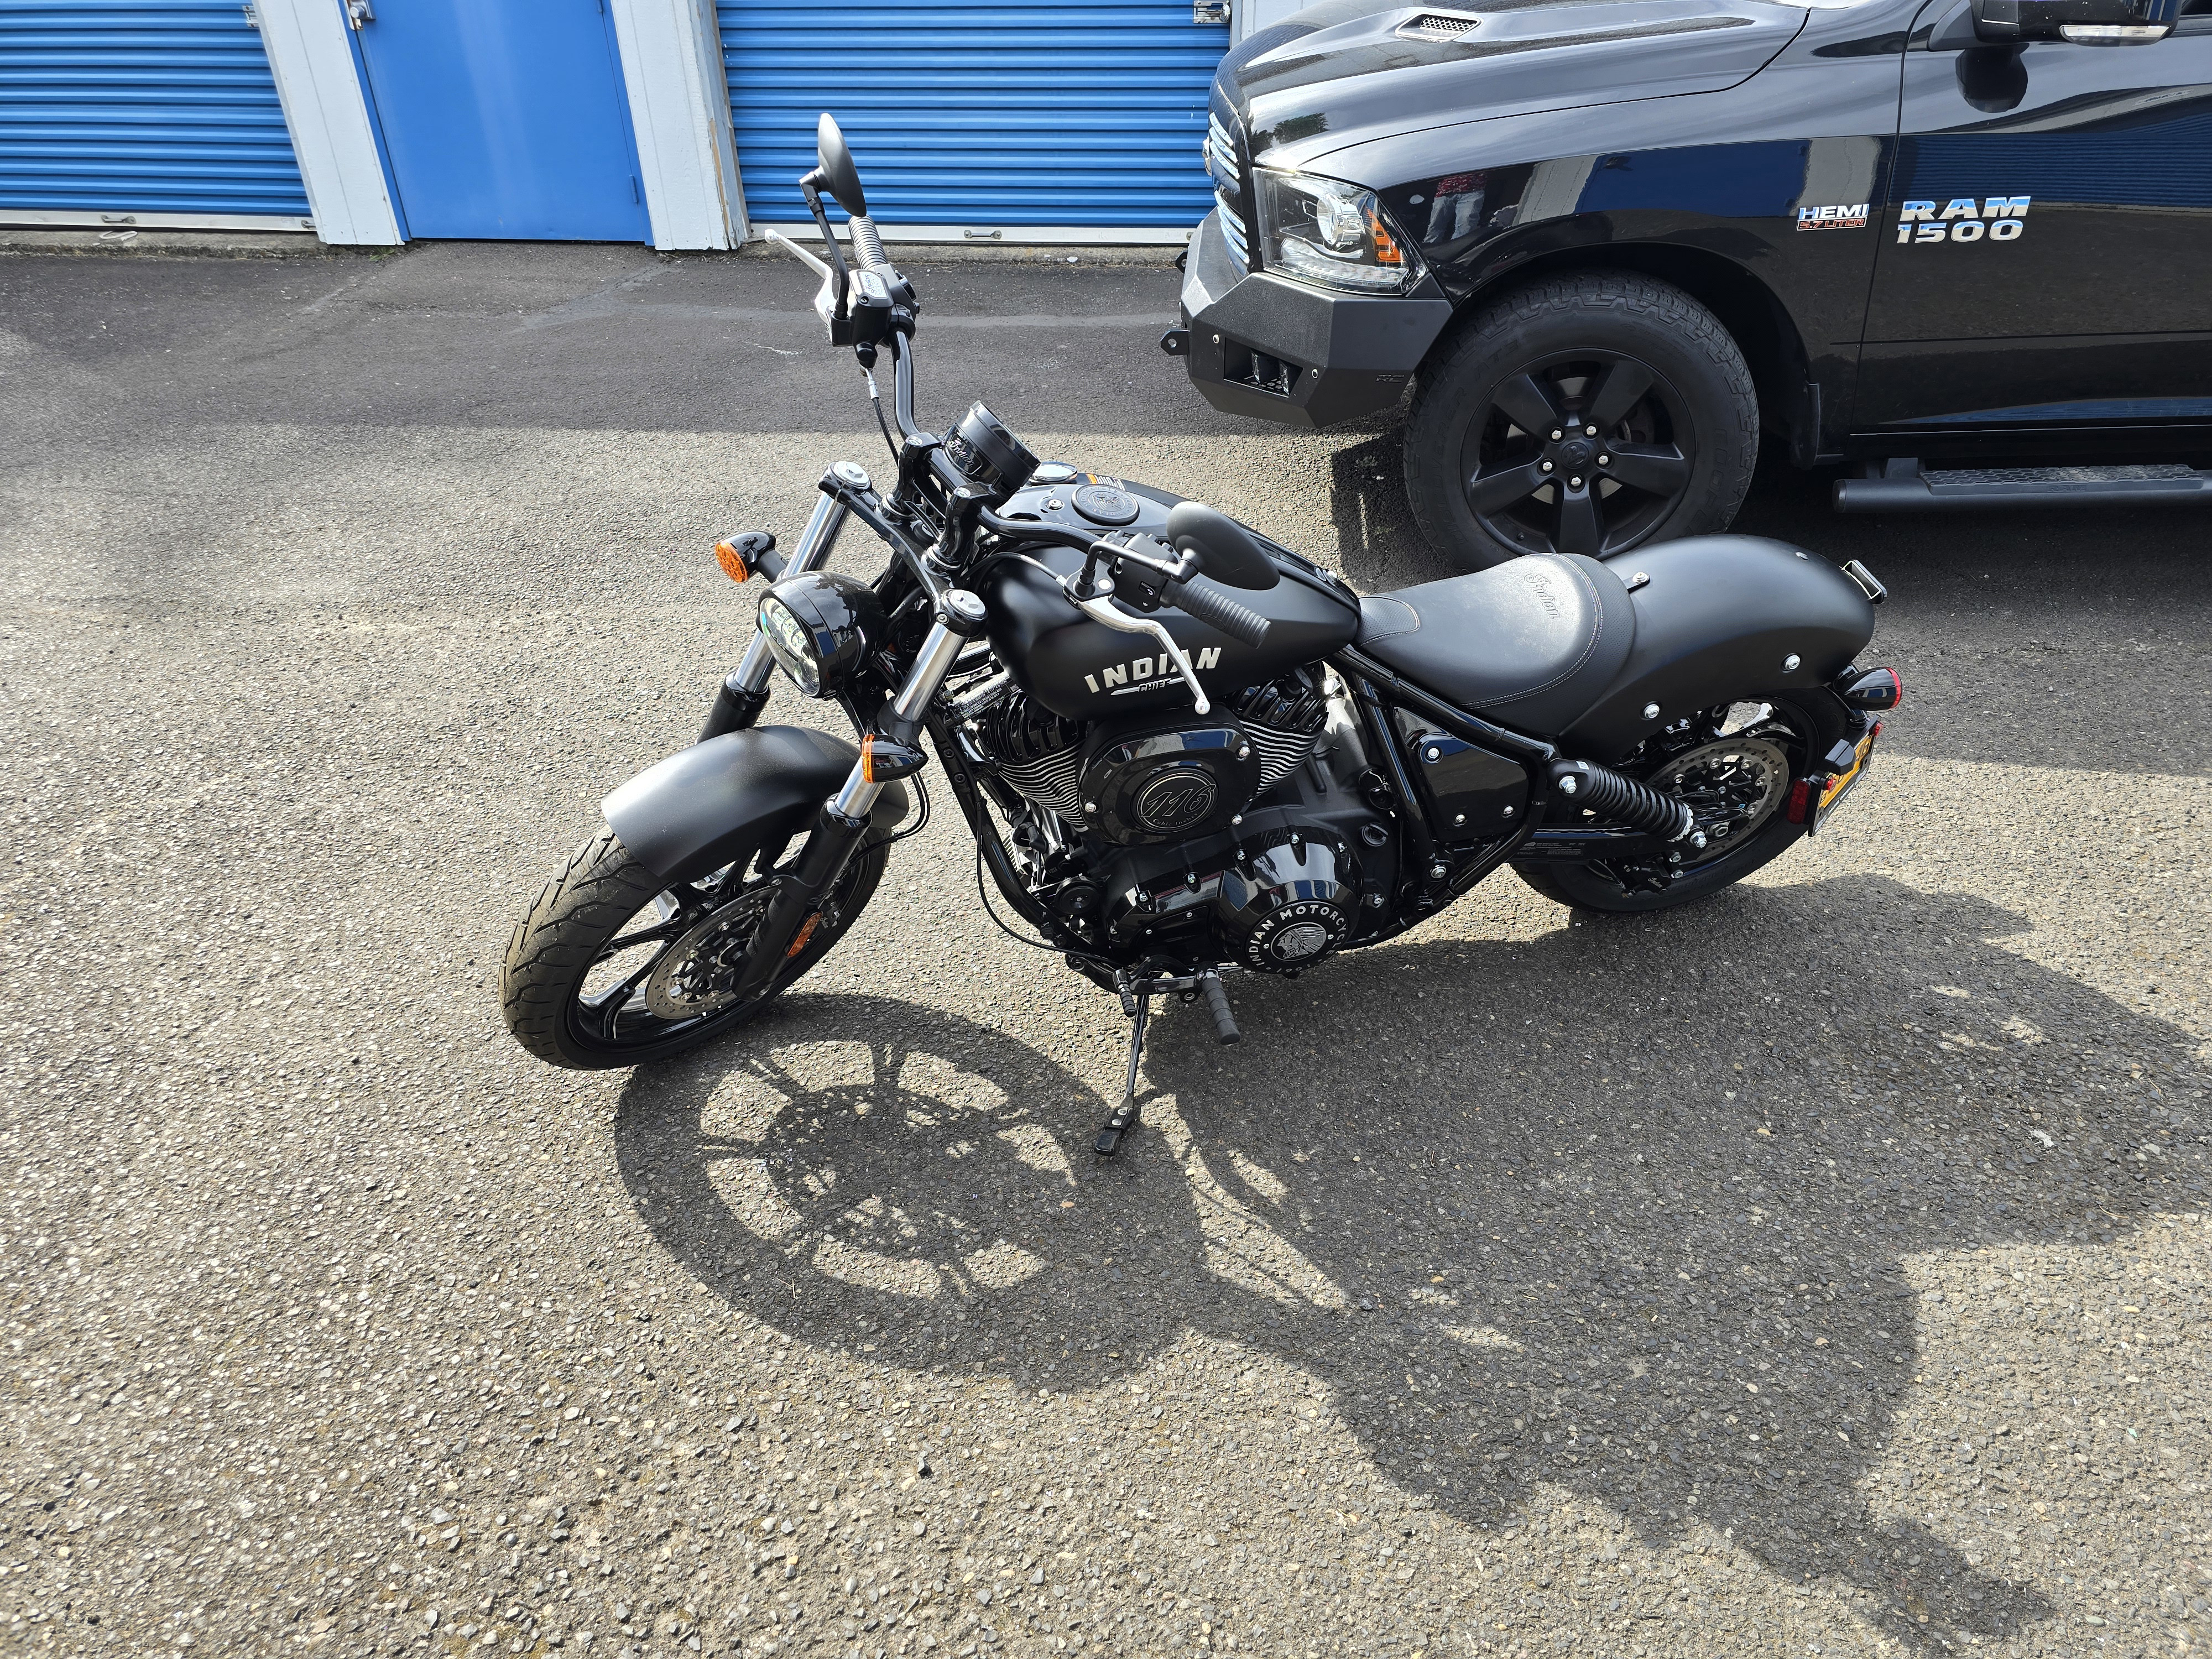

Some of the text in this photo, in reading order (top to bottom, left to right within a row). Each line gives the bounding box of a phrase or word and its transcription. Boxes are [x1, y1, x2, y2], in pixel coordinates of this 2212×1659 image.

[1799, 204, 1870, 220] HEMI
[1900, 196, 2031, 221] RAM
[1799, 218, 1864, 229] 5.7 LITER
[1896, 219, 2023, 244] 1500
[1375, 374, 1405, 383] RC
[1138, 678, 1171, 691] CHIEF
[1140, 784, 1216, 817] 116
[1249, 904, 1347, 967] INDIAN MOTORCYCLE
